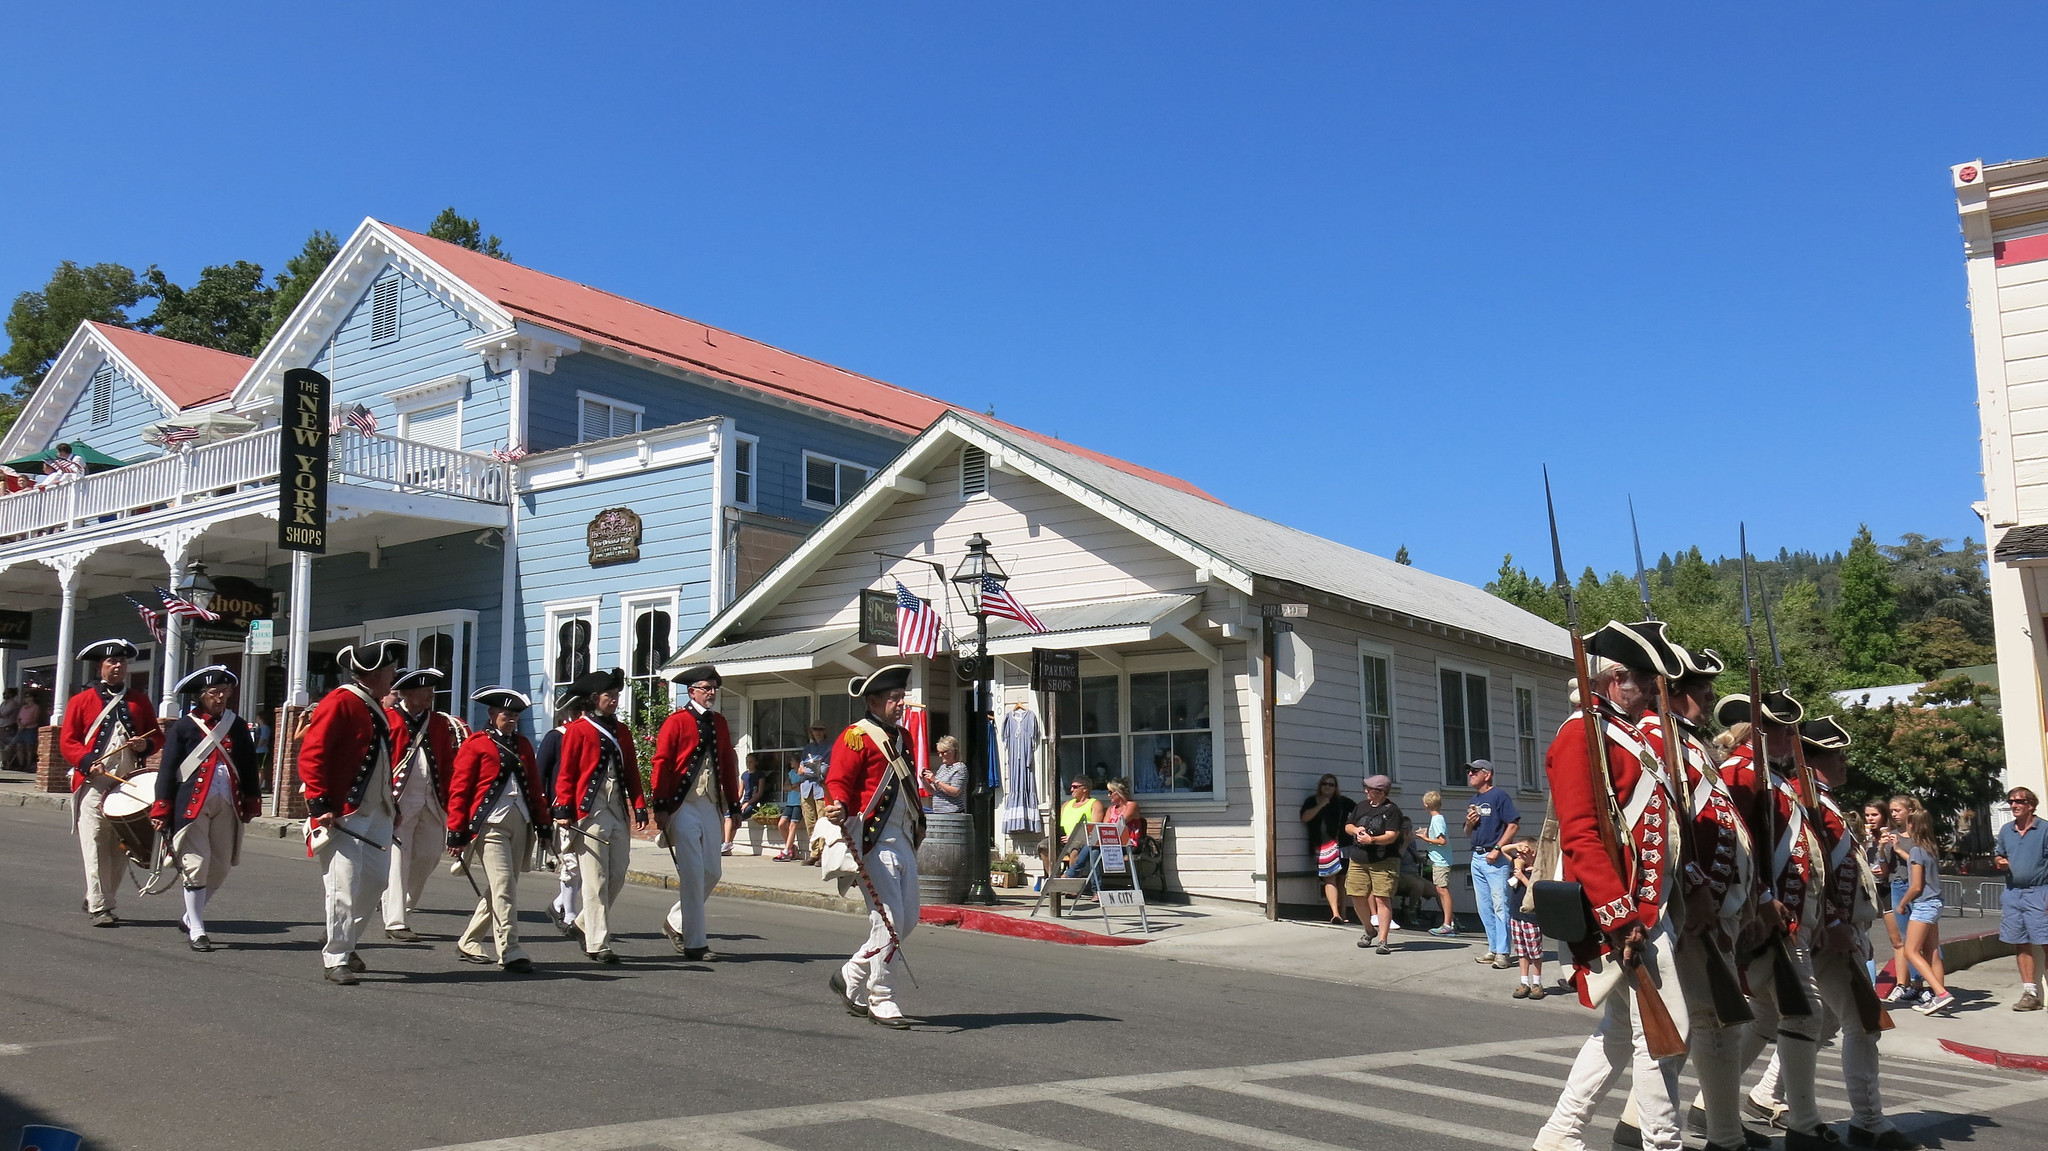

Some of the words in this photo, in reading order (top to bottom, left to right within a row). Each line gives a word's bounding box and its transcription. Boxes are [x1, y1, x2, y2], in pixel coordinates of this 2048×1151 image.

[299, 381, 319, 394] THE
[291, 394, 322, 448] NEW
[293, 454, 318, 526] YORK
[286, 526, 322, 546] SHOPS
[1263, 604, 1299, 616] BROAD
[1044, 664, 1076, 677] PARKING
[1047, 679, 1072, 691] SHOPS
[990, 873, 1005, 884] EN
[1108, 893, 1115, 904] N
[1117, 891, 1134, 904] CITY
